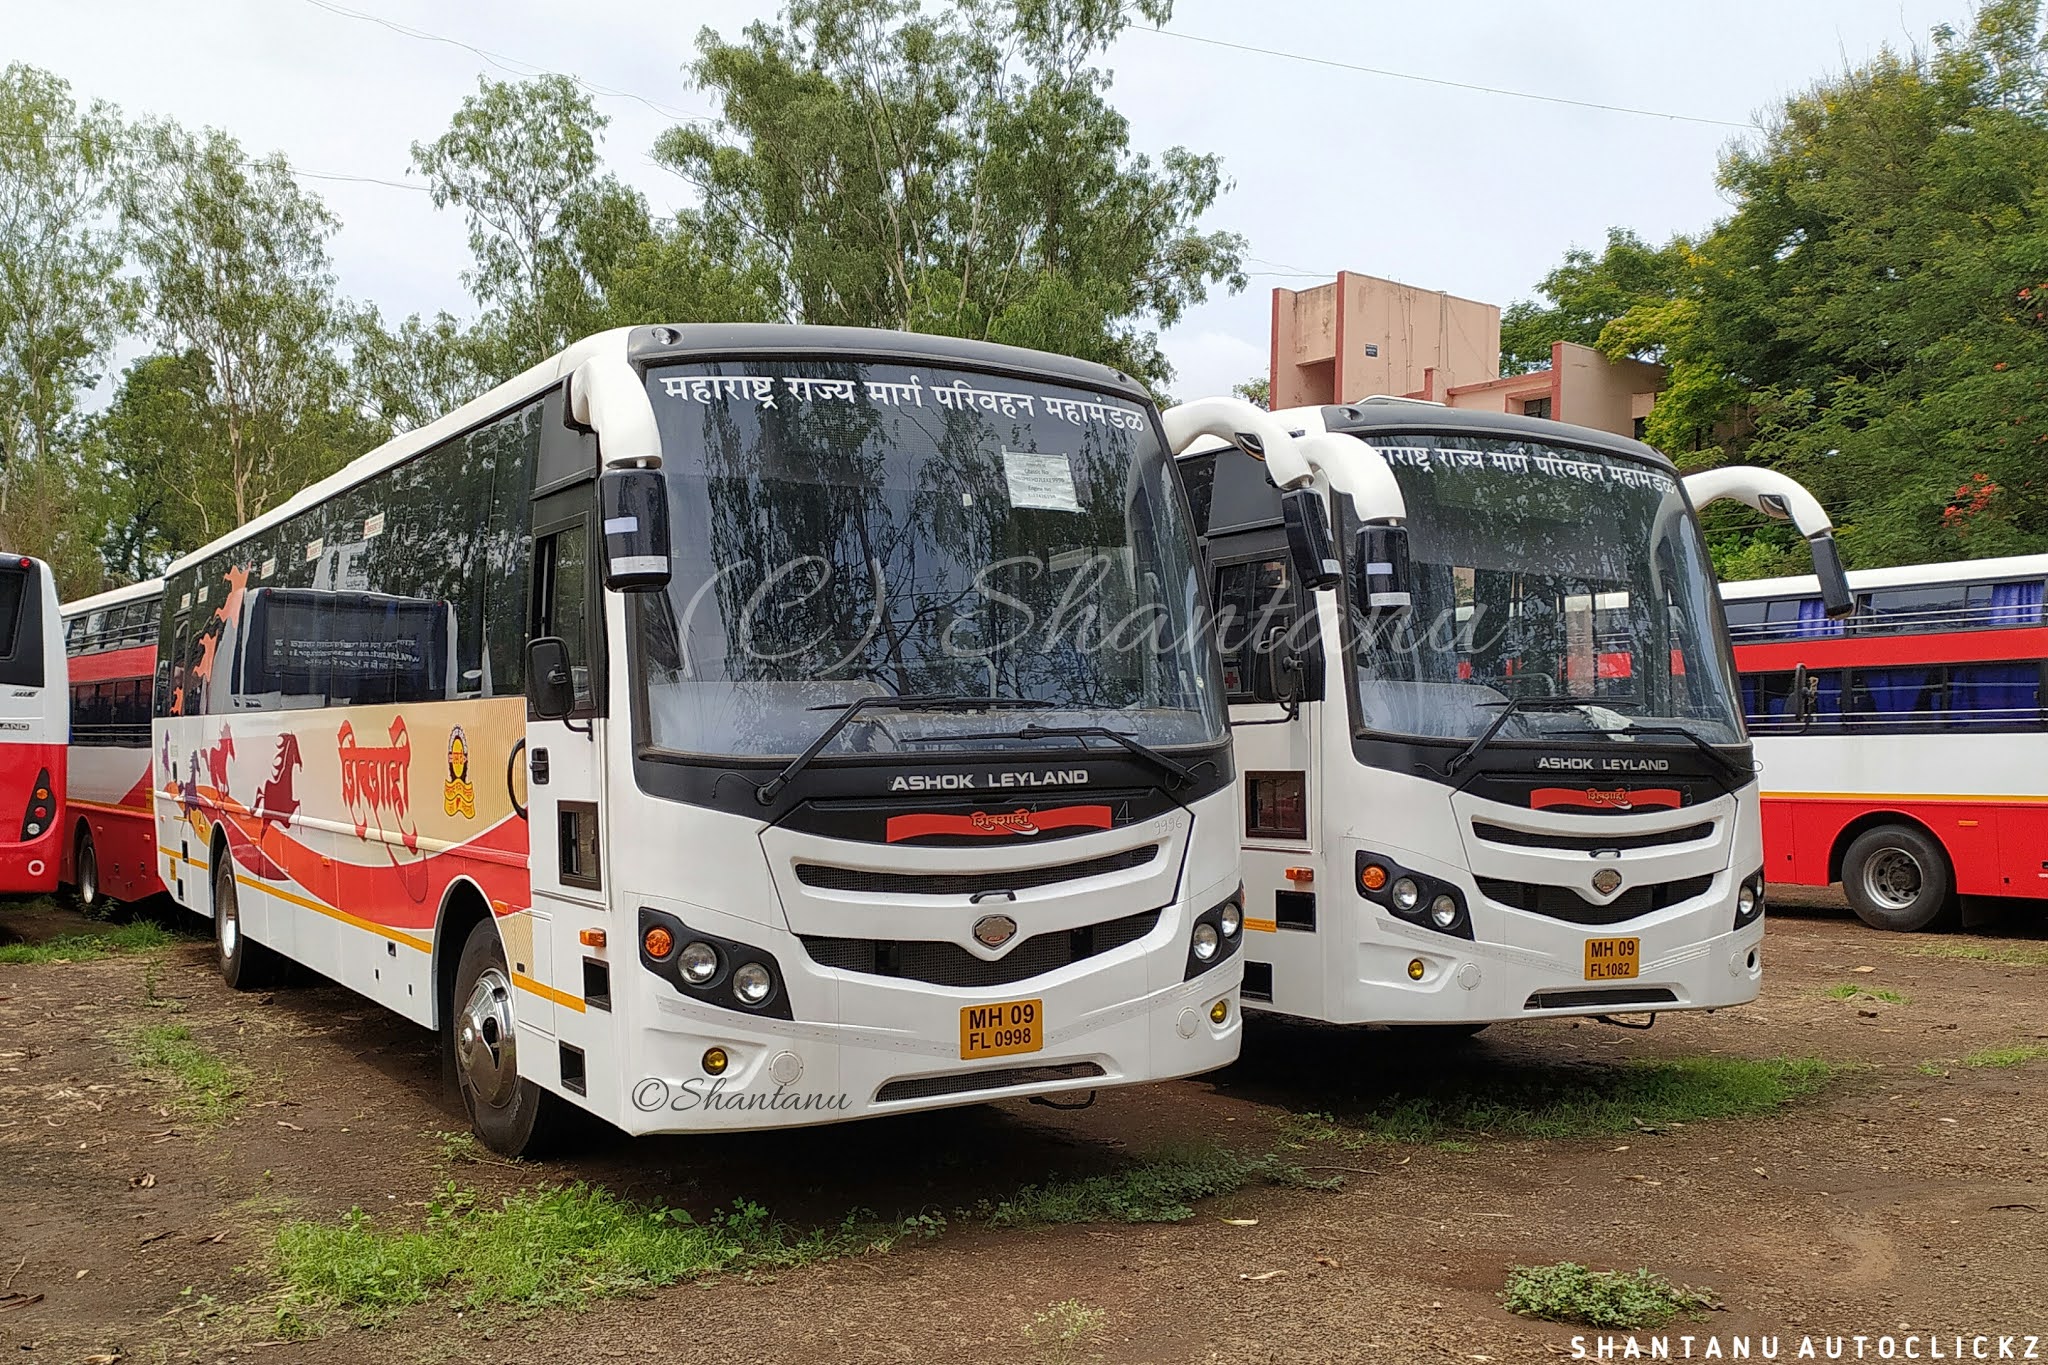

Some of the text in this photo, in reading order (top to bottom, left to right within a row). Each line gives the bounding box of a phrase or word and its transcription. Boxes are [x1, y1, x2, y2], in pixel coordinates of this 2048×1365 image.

[660, 375, 1145, 433] महाराष्ट्र राज्य मार्ग परिवहन महामंडळ
[1434, 448, 1484, 470] राज्य
[1488, 448, 1530, 474] मार्ग
[1532, 453, 1604, 484] परिवहन
[1607, 465, 1676, 494] महामंडळ
[0, 722, 29, 731] AND
[1538, 757, 1669, 771] ASHOK LEYLAND
[891, 769, 1089, 791] ASHOK LEYLAND
[970, 808, 1039, 836] शिवशाही
[1114, 800, 1134, 823] 4
[1153, 816, 1183, 836] 9996
[1591, 940, 1635, 957] MH 09
[969, 1003, 1034, 1030] MH 09
[969, 1028, 1031, 1050] FL 0998
